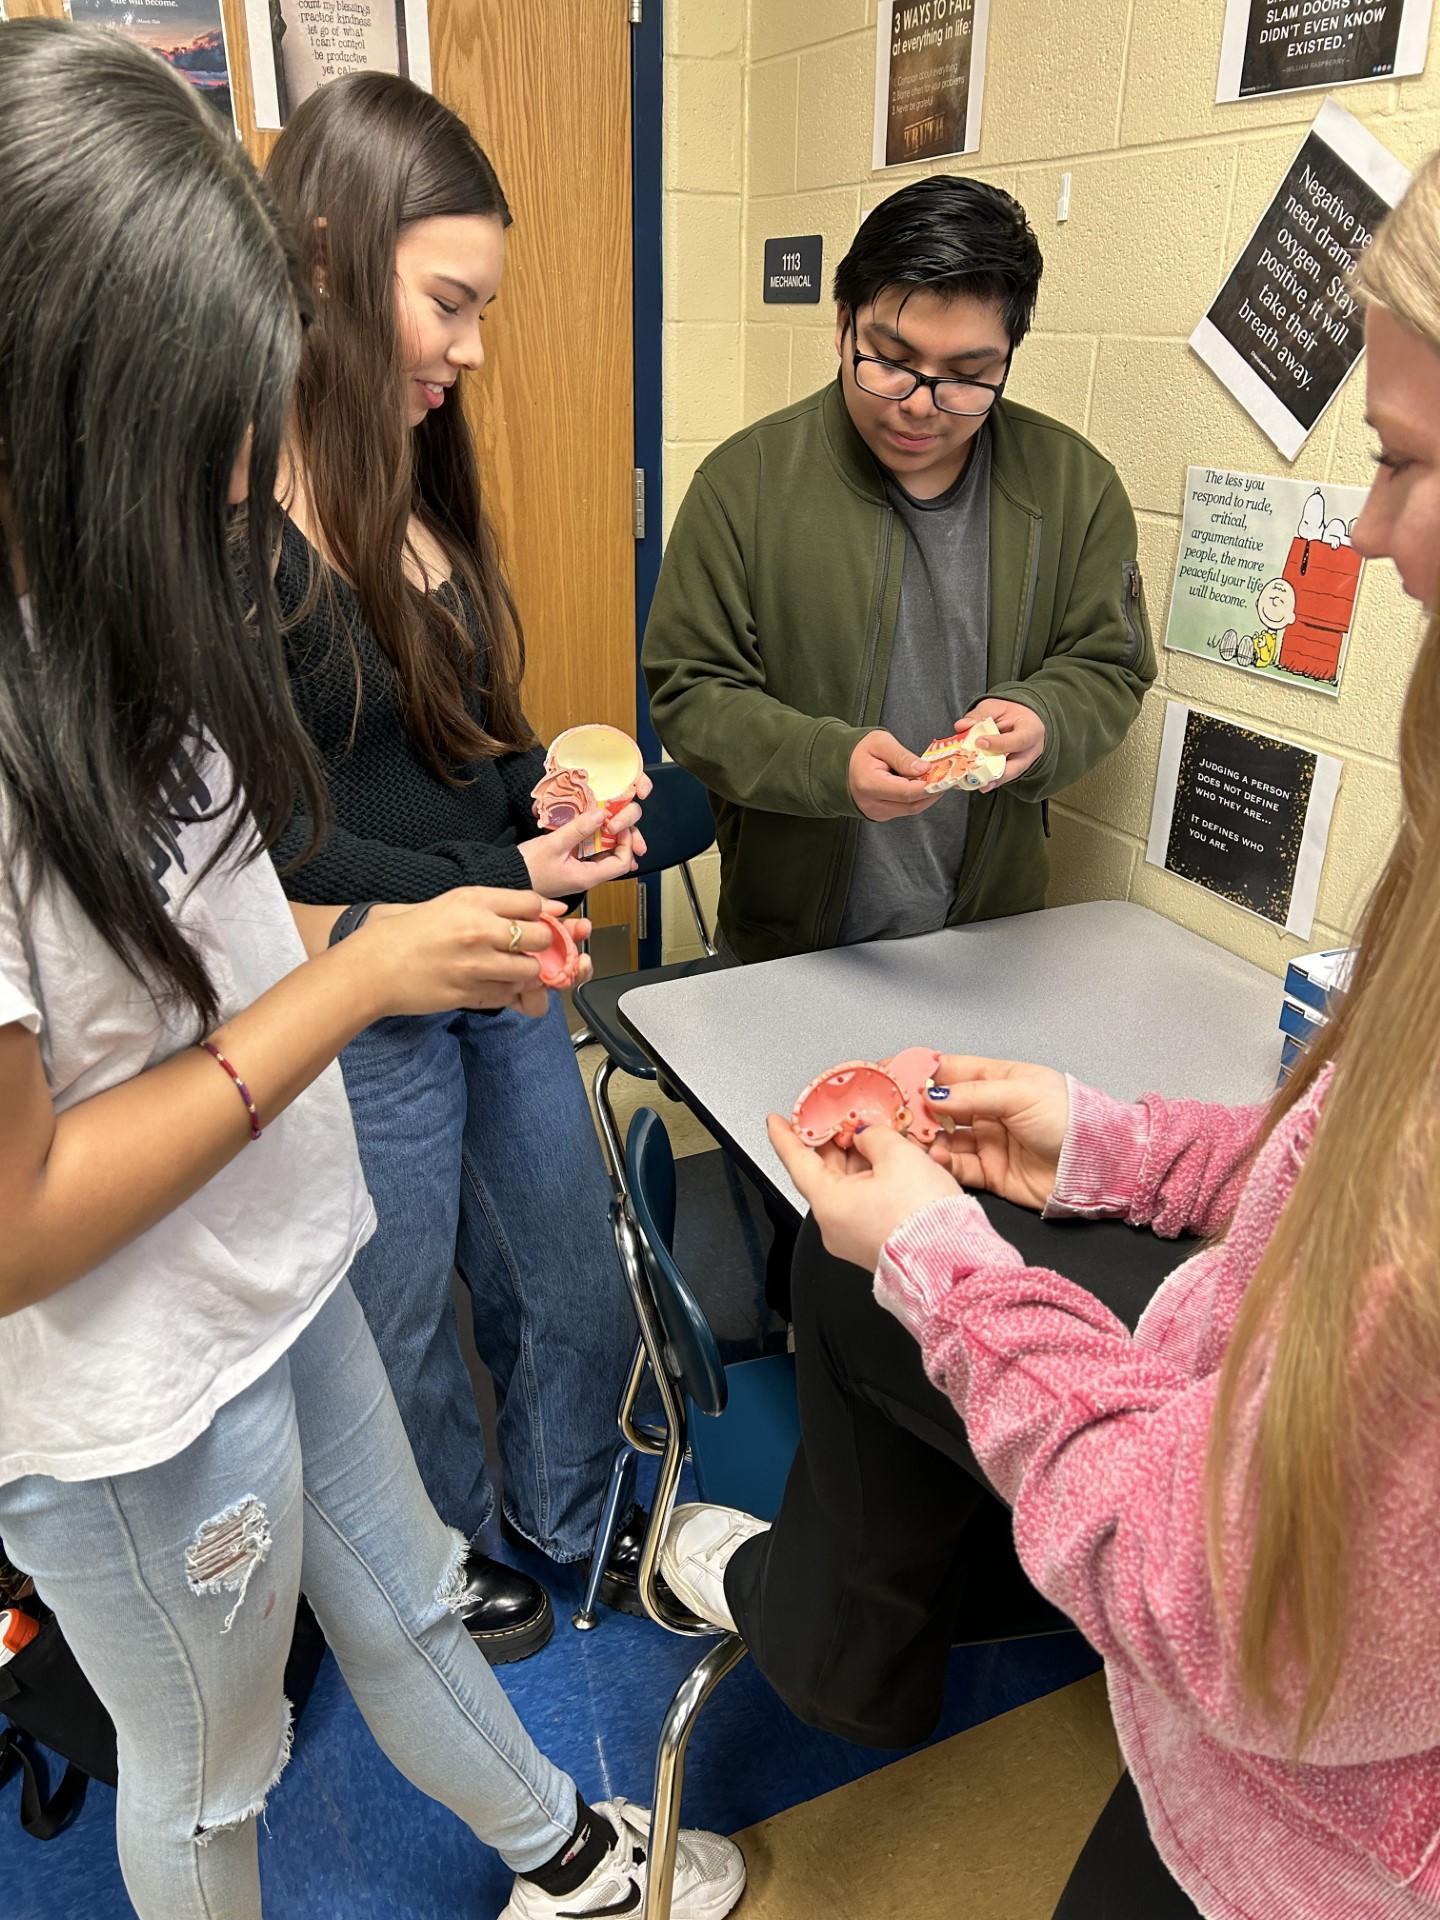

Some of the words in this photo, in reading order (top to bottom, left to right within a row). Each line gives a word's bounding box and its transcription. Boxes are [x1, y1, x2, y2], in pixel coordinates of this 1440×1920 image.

[300, 12, 334, 23] practice
[337, 14, 371, 27] kindness
[323, 1, 335, 14] my
[337, 1, 370, 17] blessings
[894, 12, 901, 34] 3
[903, 2, 931, 31] WAYS
[933, 0, 947, 20] TO
[1266, 4, 1299, 23] SLAM
[1303, 0, 1350, 16] DOORS
[308, 24, 318, 35] let
[320, 26, 329, 37] go
[332, 27, 340, 36] of
[344, 27, 364, 37] what
[892, 38, 901, 56] at
[902, 27, 943, 53] everything
[945, 22, 953, 40] in
[954, 18, 972, 37] life:
[1260, 24, 1300, 44] DIDN'T
[1304, 16, 1339, 35] EVEN
[1344, 7, 1387, 27] KNOW
[314, 49, 324, 60] be
[327, 51, 367, 63] productive
[338, 40, 365, 49] control
[1287, 33, 1353, 57] EXISTED."
[322, 65, 334, 76] yet
[932, 62, 958, 77] everything
[1299, 164, 1355, 231] Negative
[1285, 195, 1319, 234] need
[1315, 226, 1358, 276] drama
[782, 252, 801, 271] 1113
[1278, 228, 1320, 283] oxygen.
[1327, 276, 1359, 319] Stay
[770, 275, 812, 288] MECHANICAL
[1257, 248, 1308, 310] positive,
[1309, 298, 1323, 321] it
[1322, 313, 1349, 346] will
[1259, 284, 1287, 320] take
[1285, 313, 1318, 352] their
[1238, 298, 1279, 351] breath
[1277, 347, 1313, 391] away.
[1206, 470, 1223, 485] The
[1225, 473, 1243, 487] less
[1244, 479, 1265, 492] you
[1192, 491, 1234, 506] respond
[1234, 496, 1244, 508] to
[1246, 497, 1273, 516] rude,
[1211, 511, 1248, 531] critical,
[1191, 529, 1264, 551] argumentative
[1184, 547, 1218, 564] people,
[1220, 551, 1236, 566] the
[1237, 558, 1265, 571] more
[1179, 565, 1221, 583] peaceful
[1220, 574, 1246, 587] your
[1247, 576, 1264, 593] life
[1189, 585, 1208, 598] will
[1209, 587, 1248, 608] become.
[1199, 758, 1240, 780] JUDGING
[1242, 776, 1248, 784] A
[1251, 779, 1290, 800] PERSON
[1197, 773, 1220, 788] DOES
[1223, 783, 1241, 796] NOT
[1244, 792, 1280, 812] DEFINE
[1195, 786, 1216, 801] WHO
[1218, 796, 1242, 811] THEY
[1243, 808, 1272, 825] ARE...
[1189, 828, 1207, 842] YOU
[1208, 838, 1229, 852] ARE.
[1191, 814, 1200, 824] IT
[1202, 820, 1240, 841] DEFINES
[1242, 837, 1264, 852] WHO
